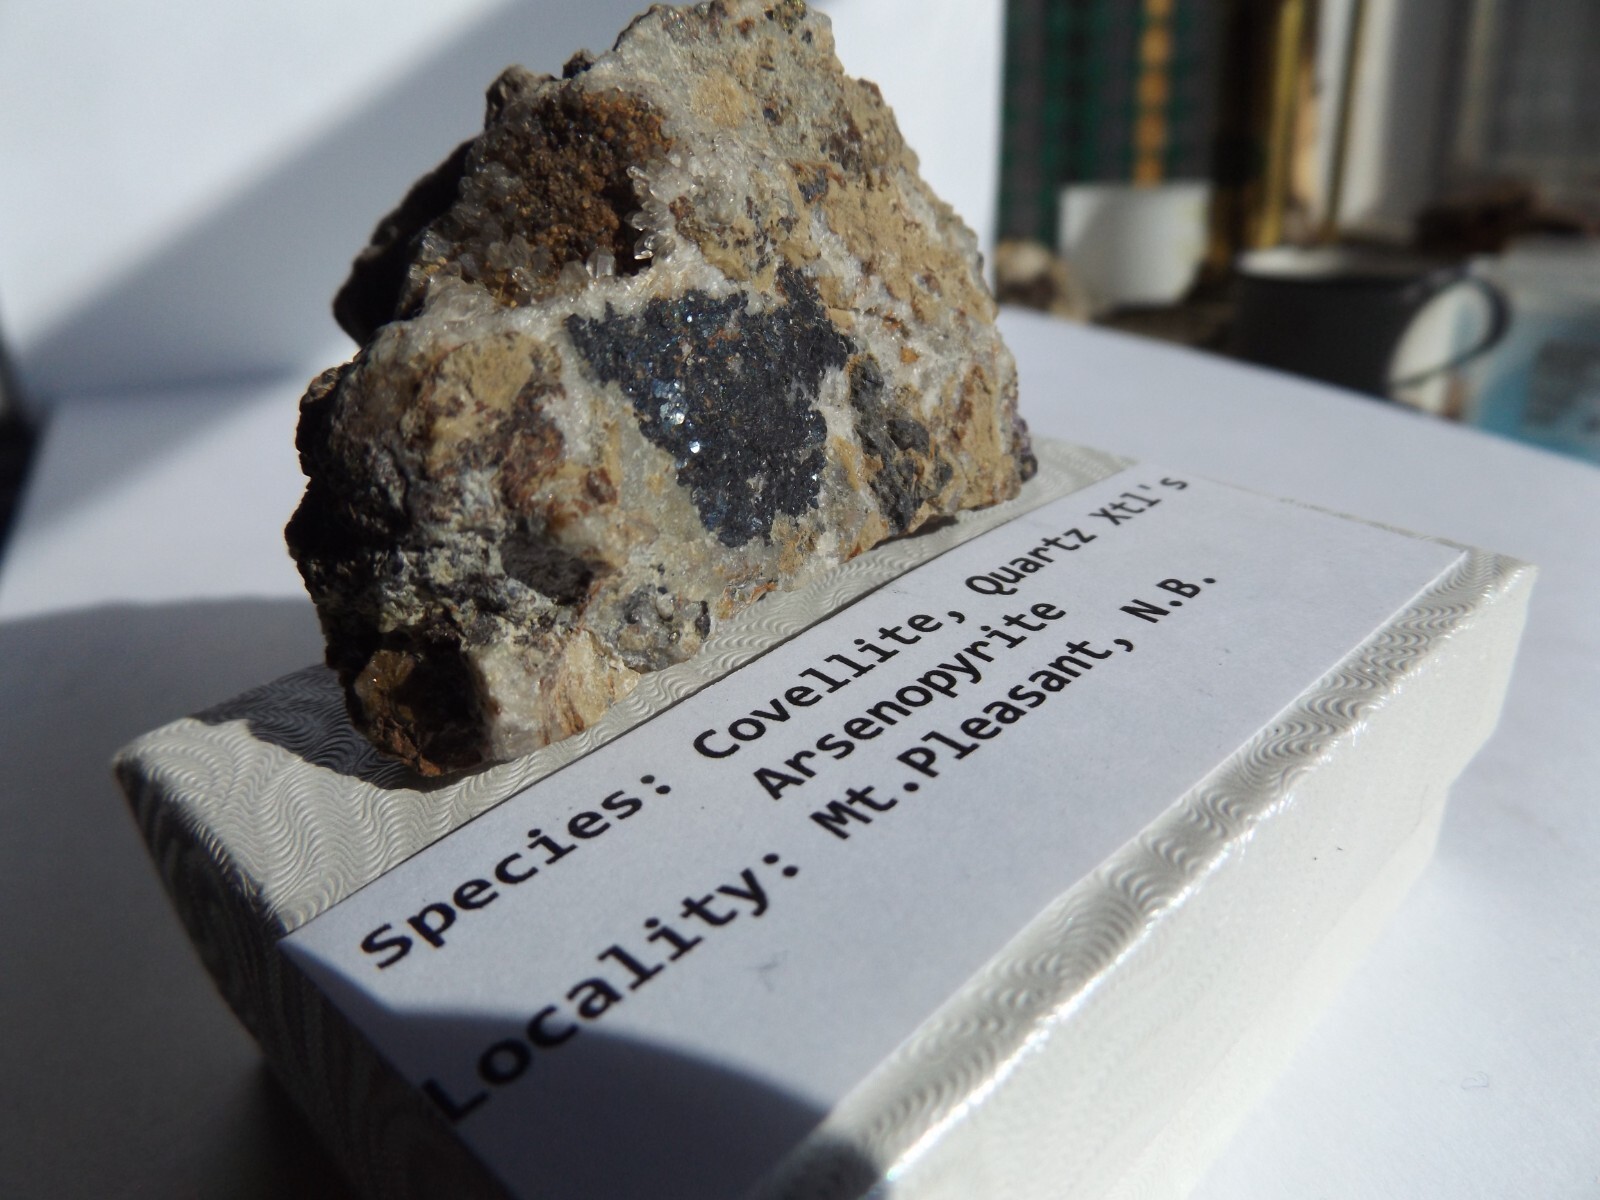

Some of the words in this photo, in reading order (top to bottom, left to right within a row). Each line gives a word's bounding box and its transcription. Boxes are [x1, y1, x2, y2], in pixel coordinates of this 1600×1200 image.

[360, 773, 672, 970] Species:
[692, 609, 968, 761] Covellite,
[964, 526, 1098, 597] Quartz
[1090, 473, 1189, 528] Xtl's
[422, 852, 800, 1122] Locality:
[1120, 575, 1218, 625] N.B.
[753, 600, 1067, 801] Arsenopyrite
